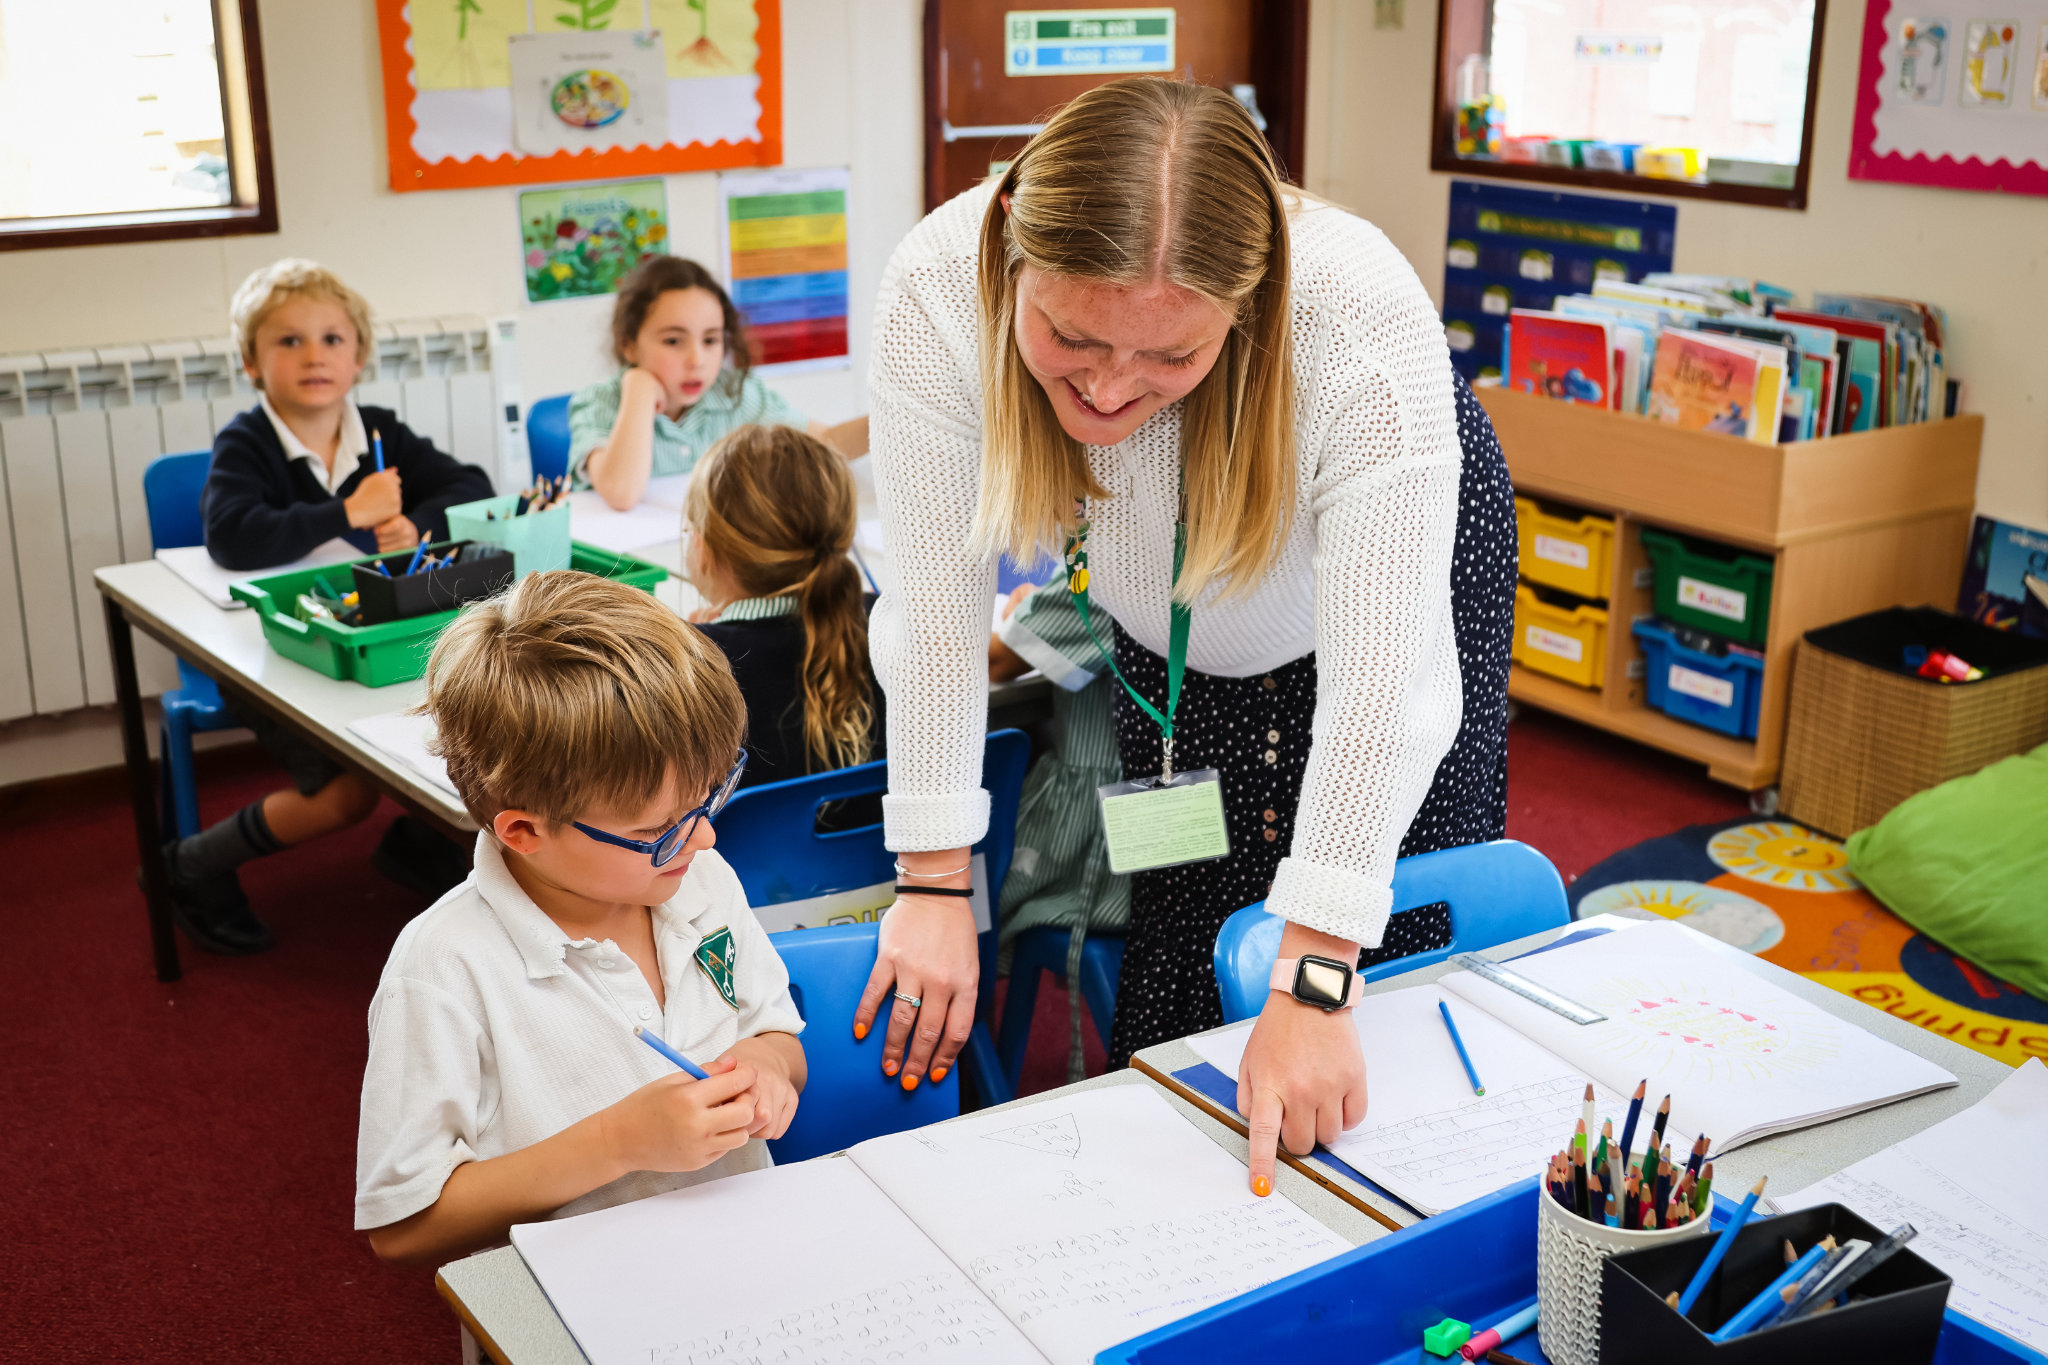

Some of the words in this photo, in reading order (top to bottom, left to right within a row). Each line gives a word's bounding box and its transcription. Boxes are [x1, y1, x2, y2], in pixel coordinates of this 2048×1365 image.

[1069, 21, 1103, 37] Fire
[1105, 20, 1137, 36] exit
[561, 199, 629, 219] Plants
